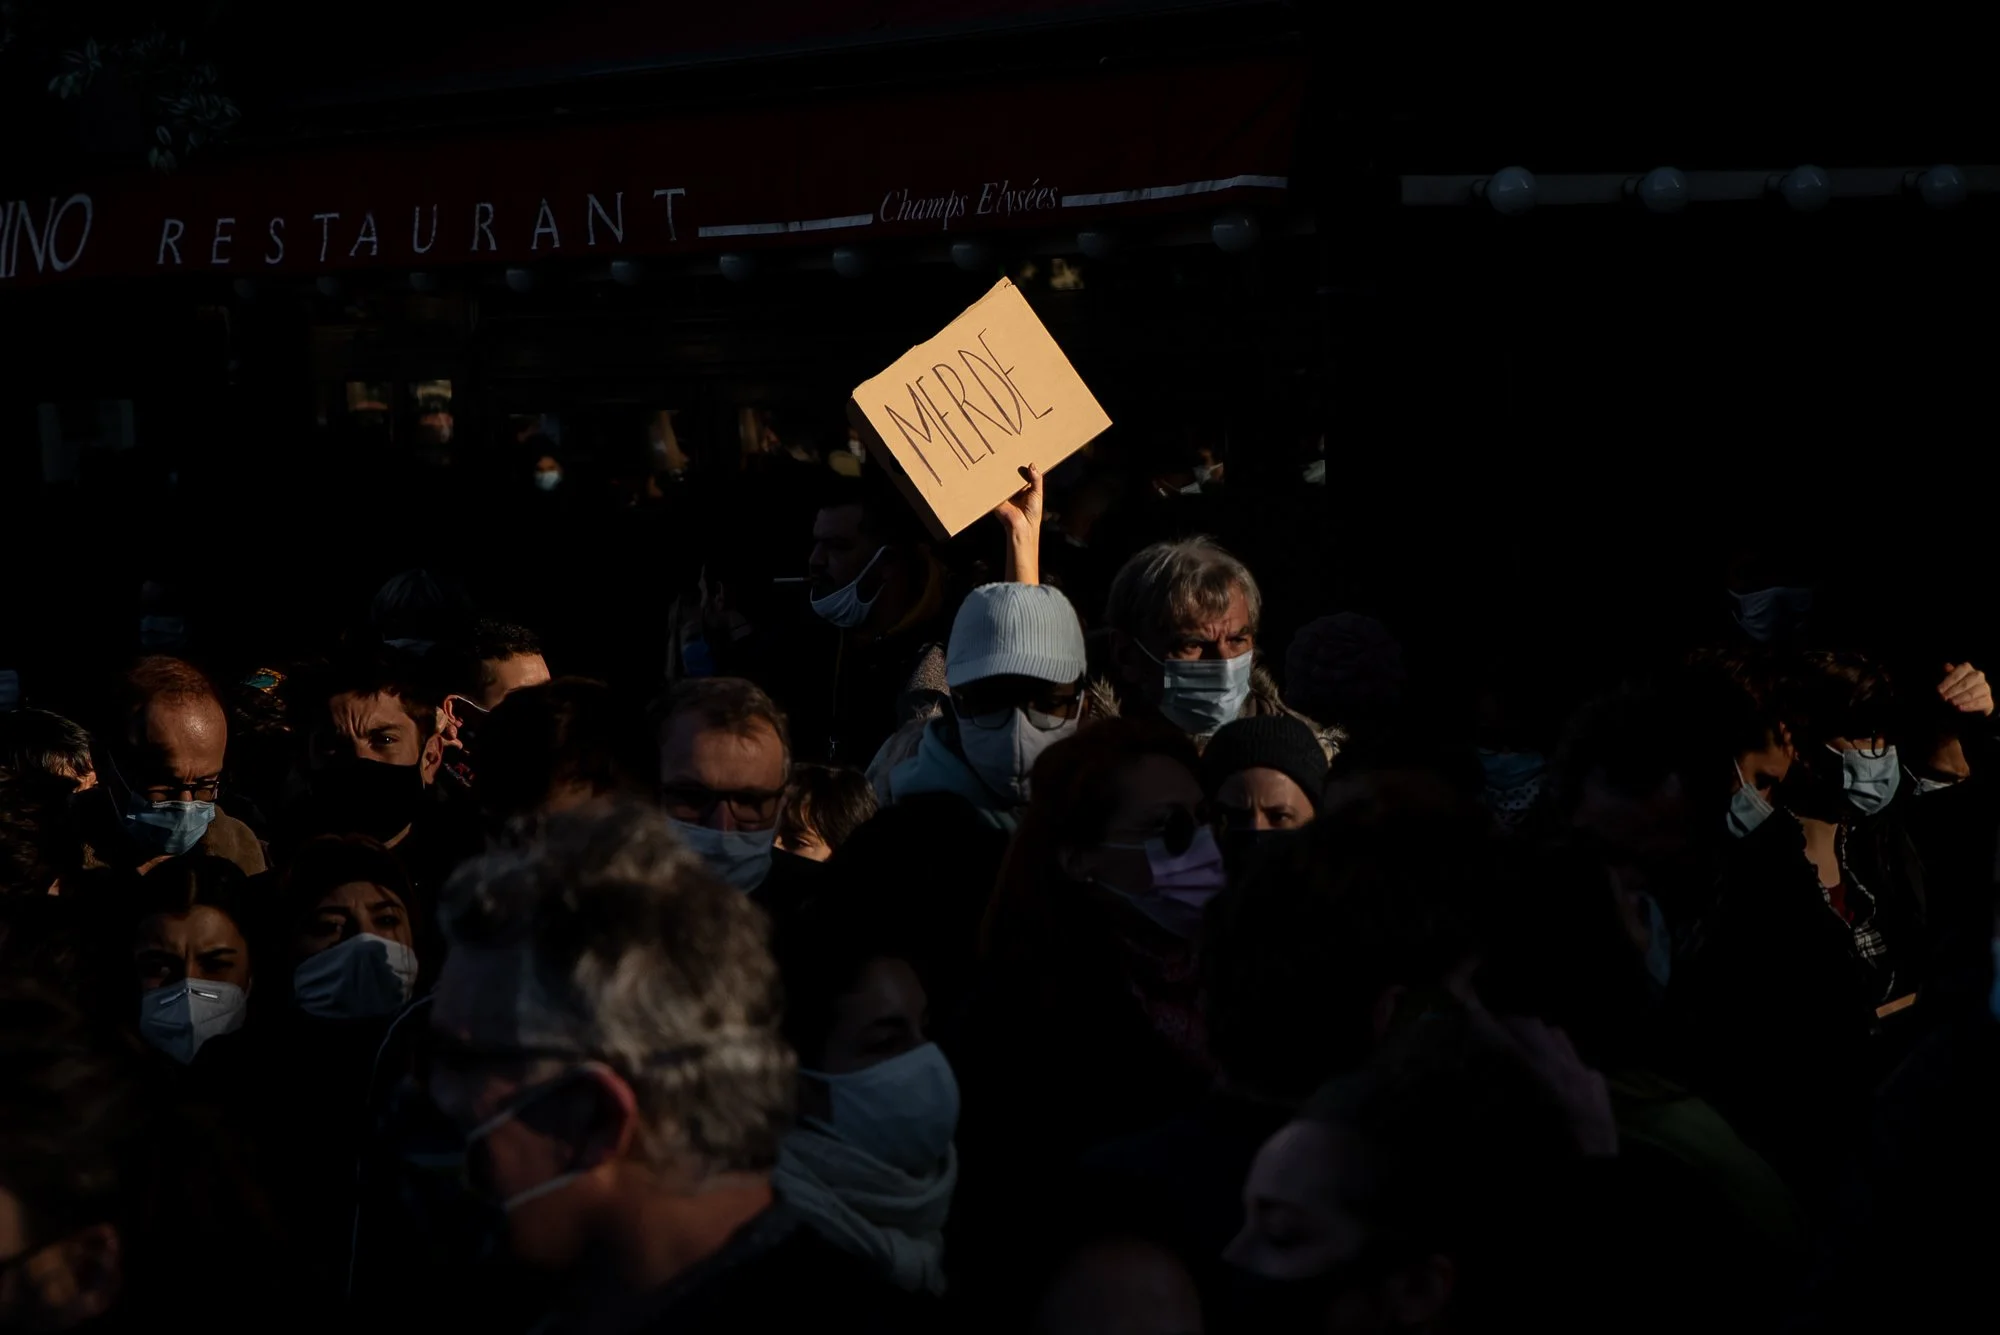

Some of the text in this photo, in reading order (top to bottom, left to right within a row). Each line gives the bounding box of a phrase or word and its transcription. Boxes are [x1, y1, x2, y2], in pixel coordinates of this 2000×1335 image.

[0, 192, 93, 278] INO
[157, 188, 686, 265] RESTAURANT
[880, 188, 969, 231] Champs
[884, 328, 1054, 487] MERDE
